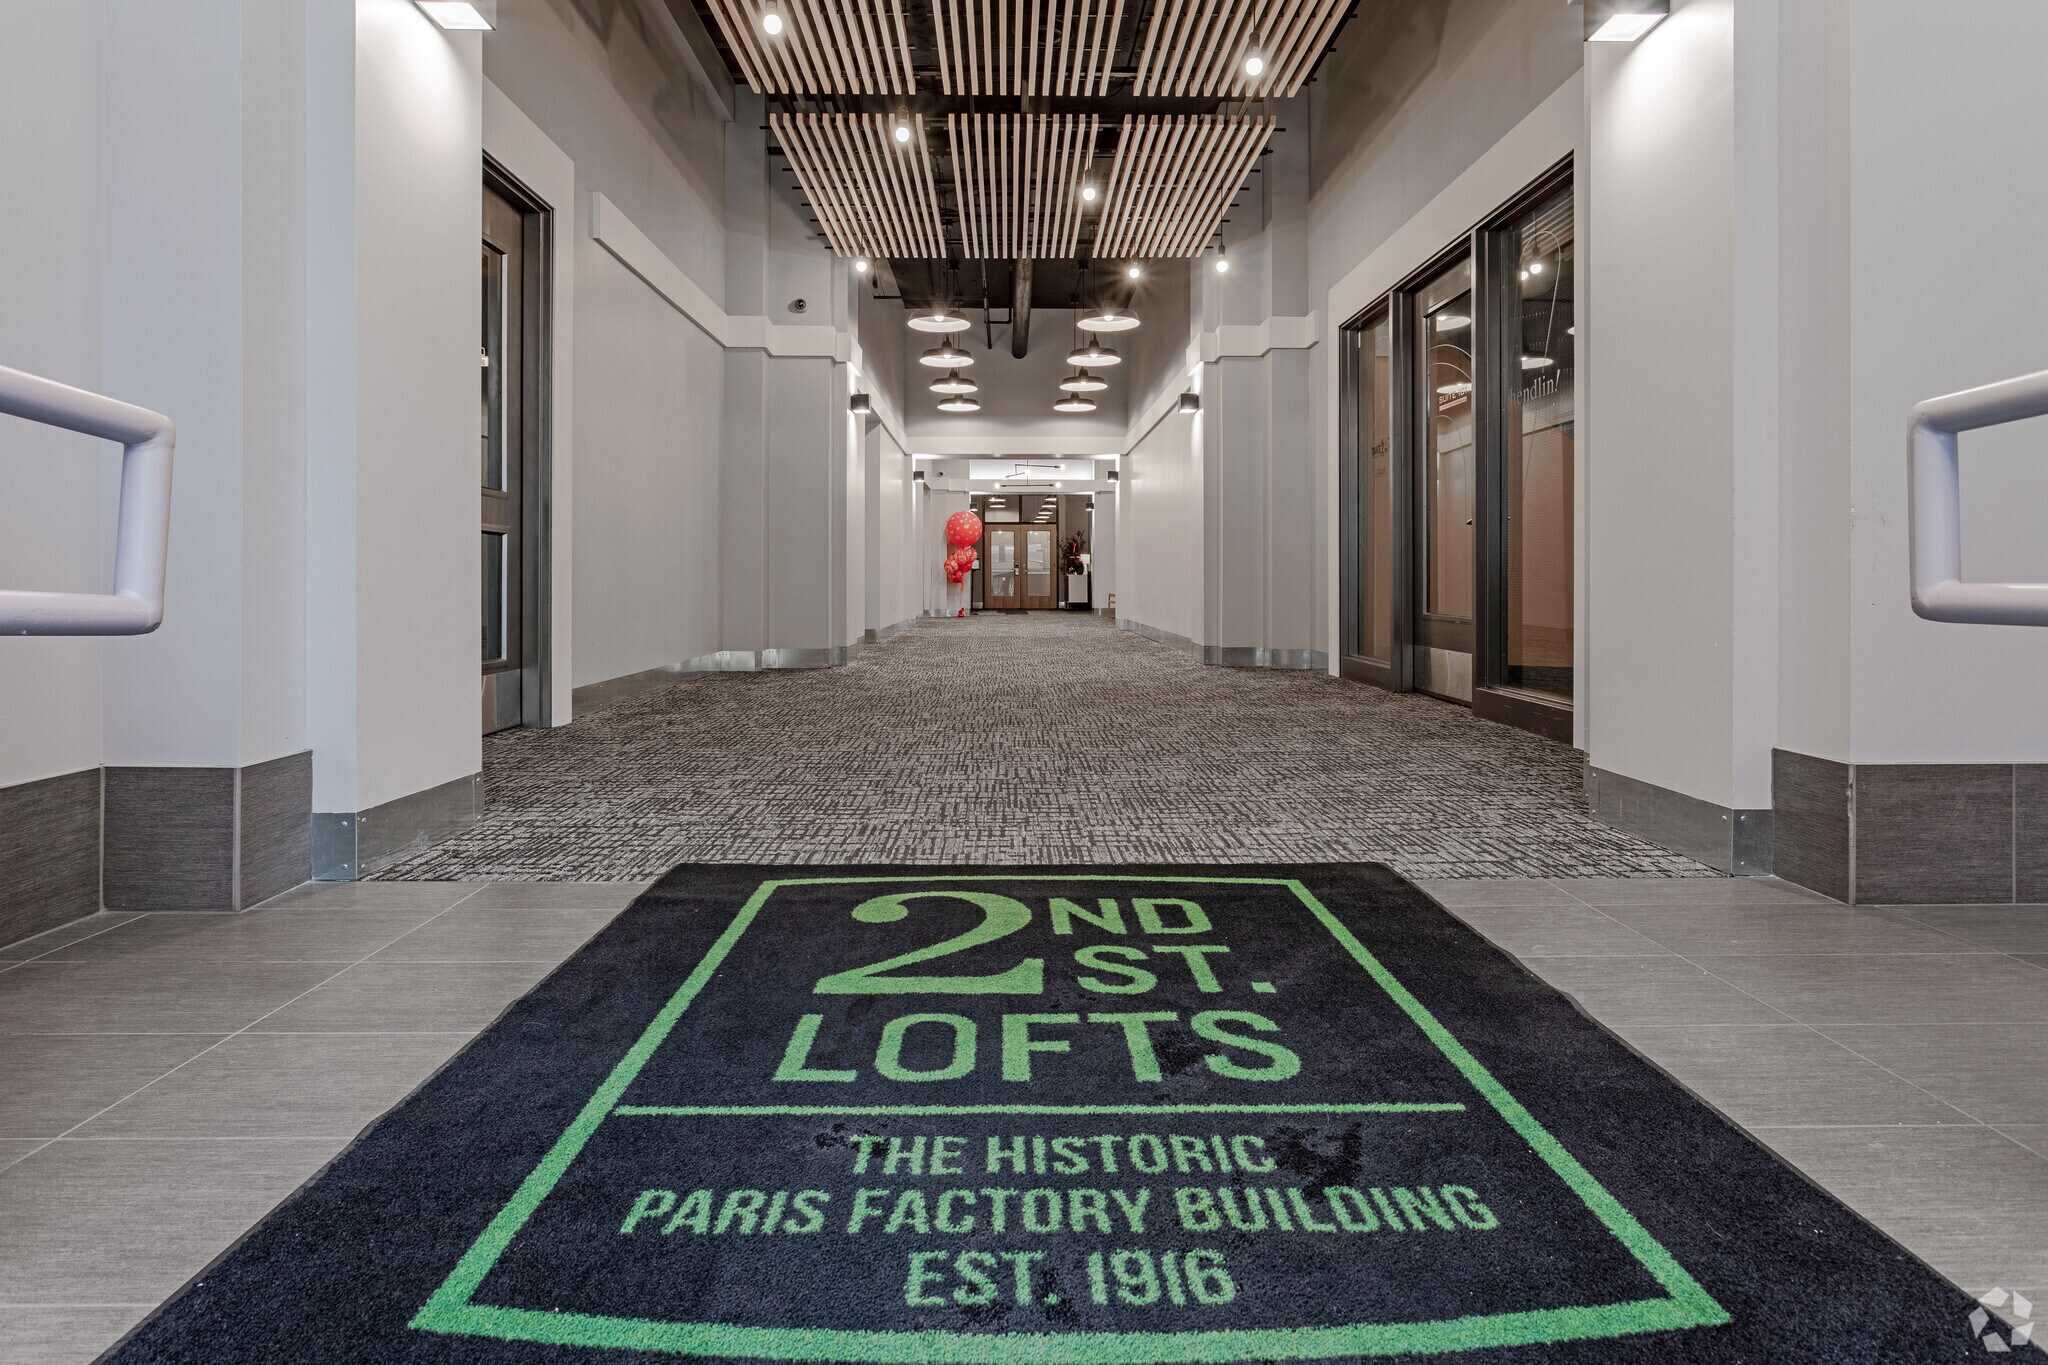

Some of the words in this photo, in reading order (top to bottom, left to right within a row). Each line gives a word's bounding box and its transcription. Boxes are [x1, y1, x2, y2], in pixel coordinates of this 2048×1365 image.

[1075, 945, 1276, 994] ST.
[774, 1013, 1302, 1083] LOFTS
[852, 1136, 965, 1174] THE
[988, 1136, 1276, 1174] HISTORIC
[622, 1190, 829, 1234] PARIS
[848, 1189, 1149, 1233] FACTORY
[1176, 1185, 1499, 1232] BUILDING
[906, 1252, 1058, 1306] EST.
[1089, 1250, 1236, 1305] 1916
